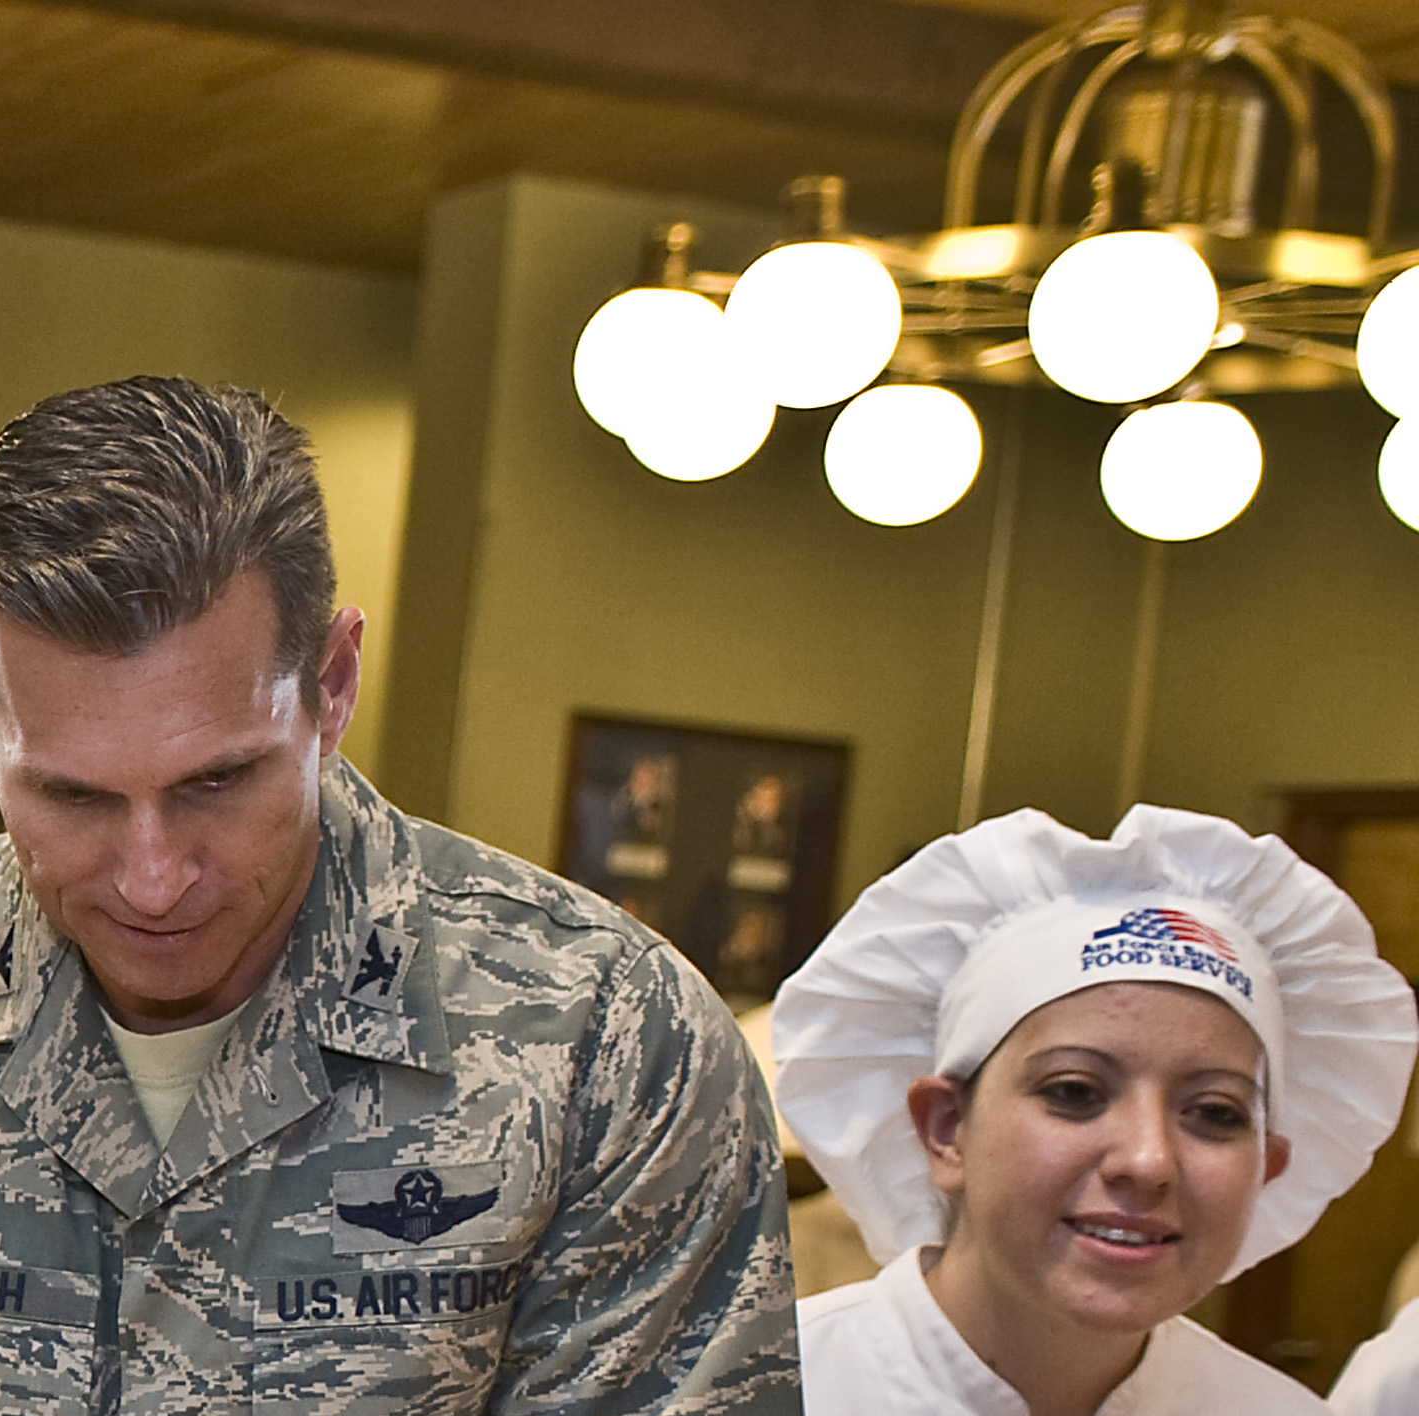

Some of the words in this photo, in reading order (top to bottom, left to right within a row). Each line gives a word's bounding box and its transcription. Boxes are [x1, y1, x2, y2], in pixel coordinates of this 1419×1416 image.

[1082, 944, 1112, 955] AIR
[1119, 939, 1176, 951] FORCE
[1082, 951, 1153, 972] FOOD
[1159, 953, 1253, 1002] SERVICE
[277, 1278, 345, 1322] U.S.
[355, 1272, 421, 1317] AIR
